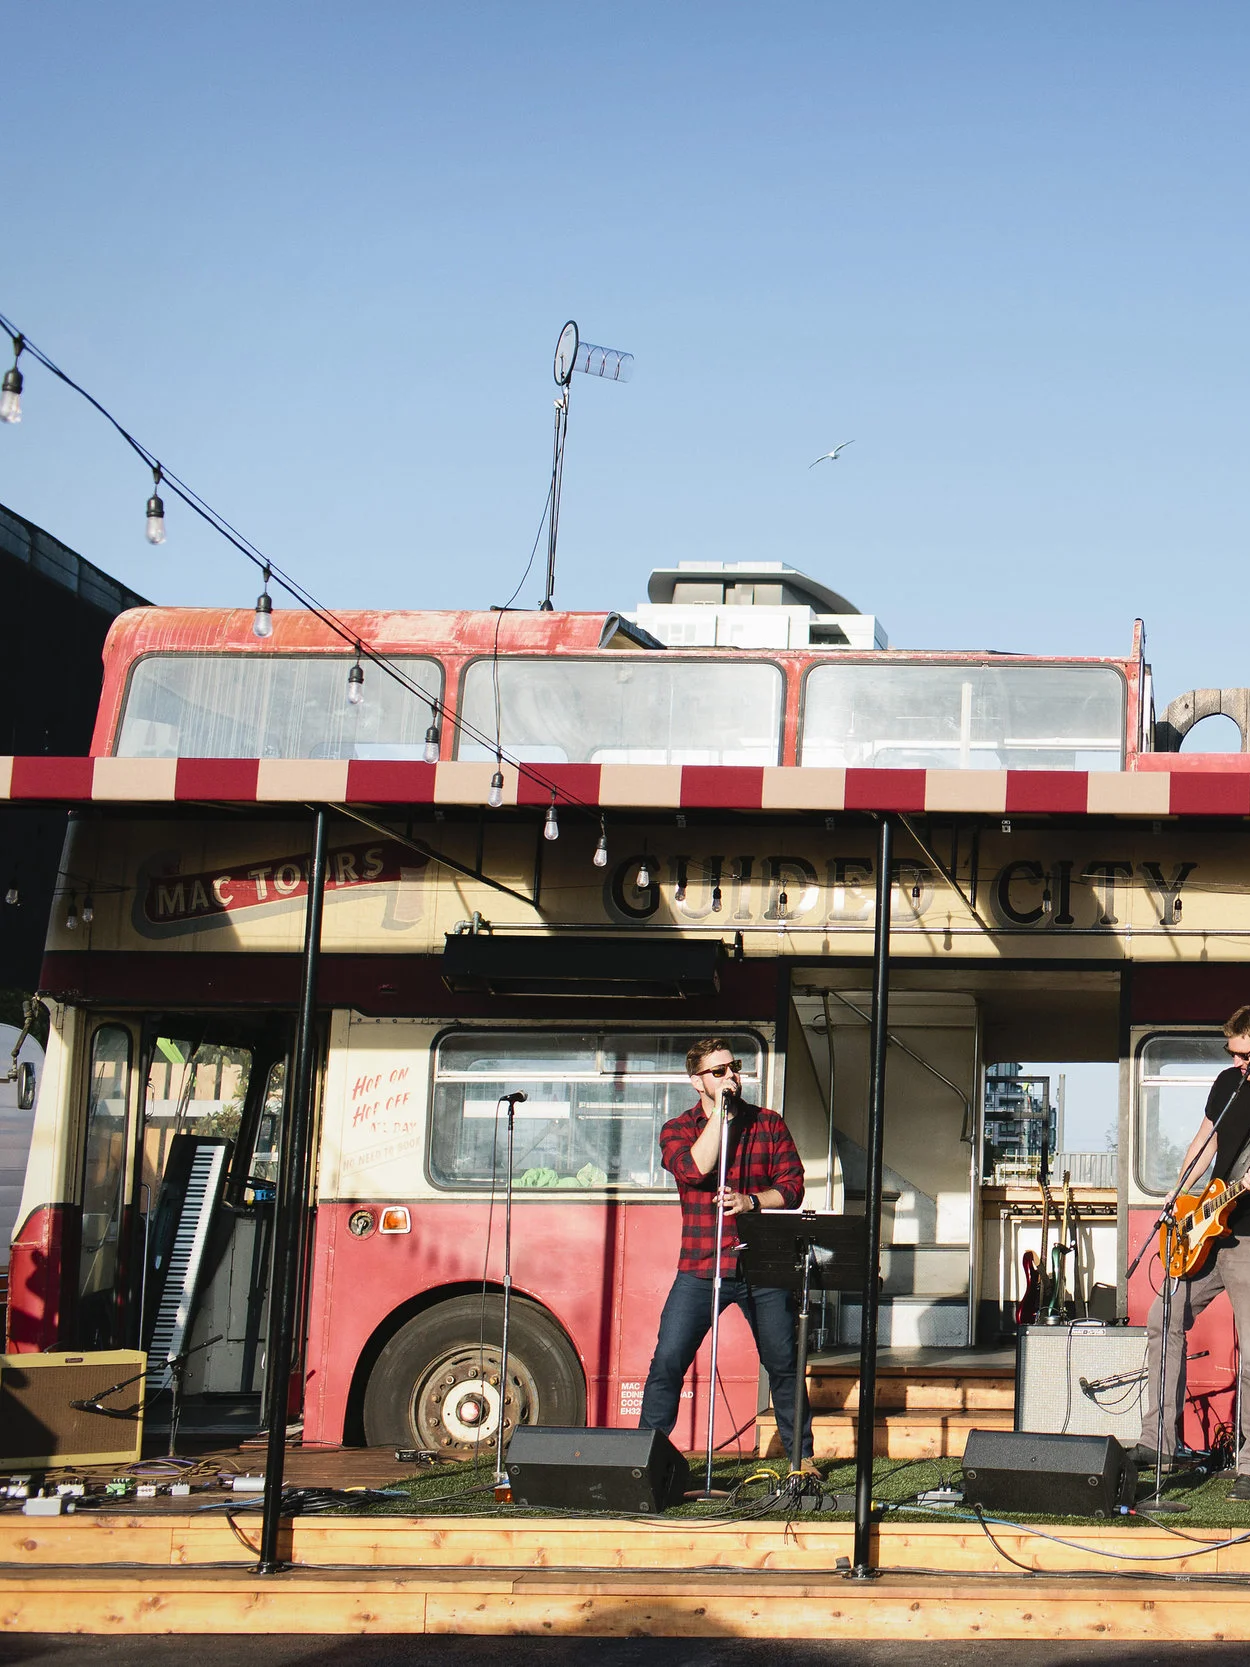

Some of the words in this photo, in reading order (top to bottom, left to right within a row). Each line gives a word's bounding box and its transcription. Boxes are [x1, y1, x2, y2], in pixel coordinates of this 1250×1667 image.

[156, 876, 233, 916] MAC
[609, 854, 933, 925] GUIDED
[998, 860, 1197, 927] CITY
[352, 1073, 382, 1100] HOP
[389, 1067, 409, 1082] ON
[352, 1101, 380, 1128] HOP
[621, 1382, 640, 1390] MAC
